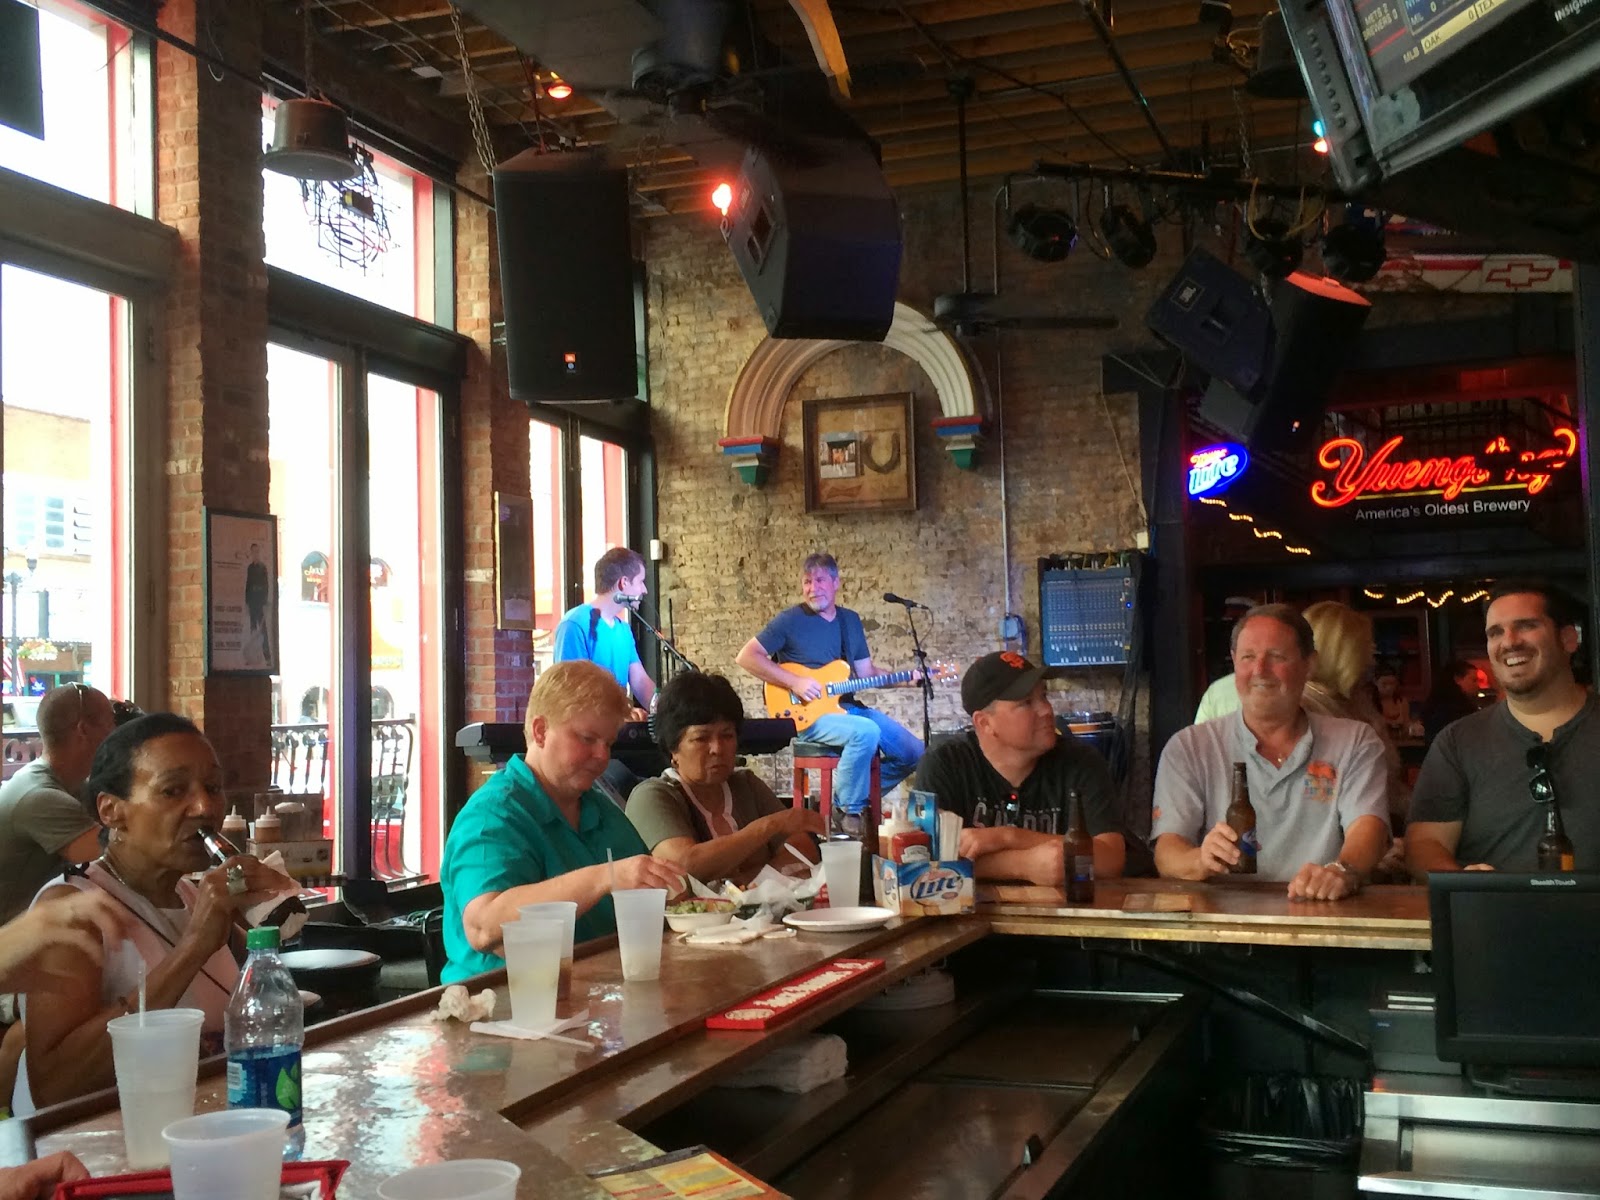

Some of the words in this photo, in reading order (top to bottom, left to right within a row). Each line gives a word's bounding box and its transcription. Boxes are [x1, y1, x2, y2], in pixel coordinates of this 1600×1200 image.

[1554, 0, 1592, 21] INSIGN
[1424, 33, 1441, 49] OAK
[1311, 427, 1577, 508] Yueng
[1355, 505, 1421, 521] America's
[1424, 502, 1470, 517] Oldest
[1473, 499, 1531, 514] Brewery
[916, 876, 959, 899] Lite
